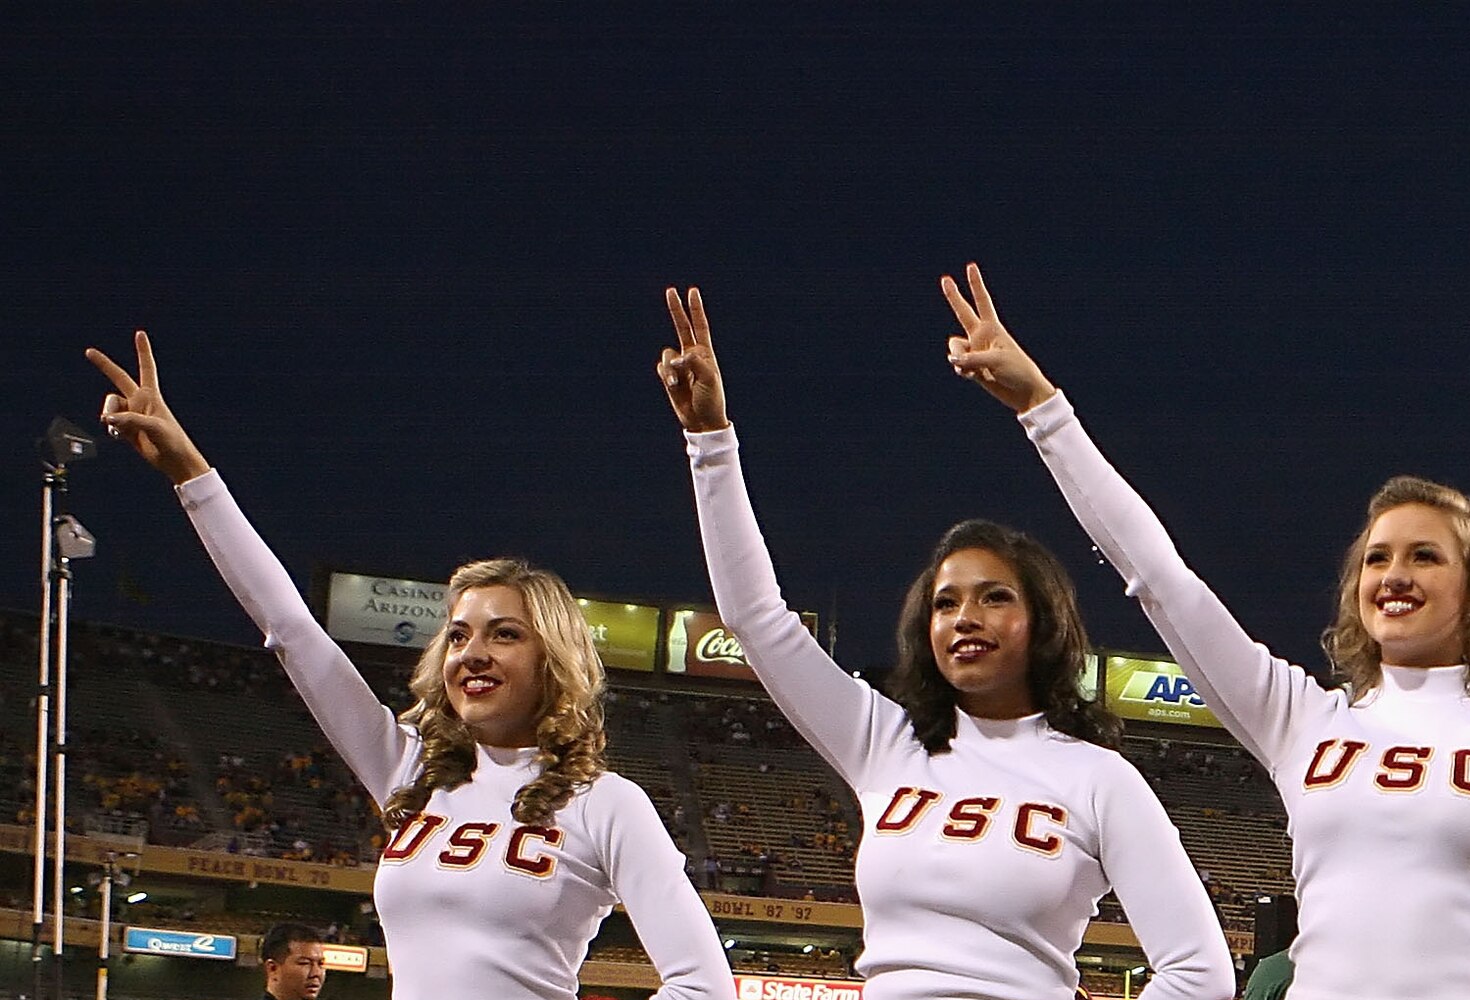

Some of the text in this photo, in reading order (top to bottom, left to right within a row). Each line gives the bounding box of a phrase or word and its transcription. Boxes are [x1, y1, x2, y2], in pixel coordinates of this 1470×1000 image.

[1147, 707, 1191, 719] aps.com
[874, 786, 1069, 858] USC
[383, 811, 565, 880] USC
[711, 901, 812, 920] BOWL '87 '97
